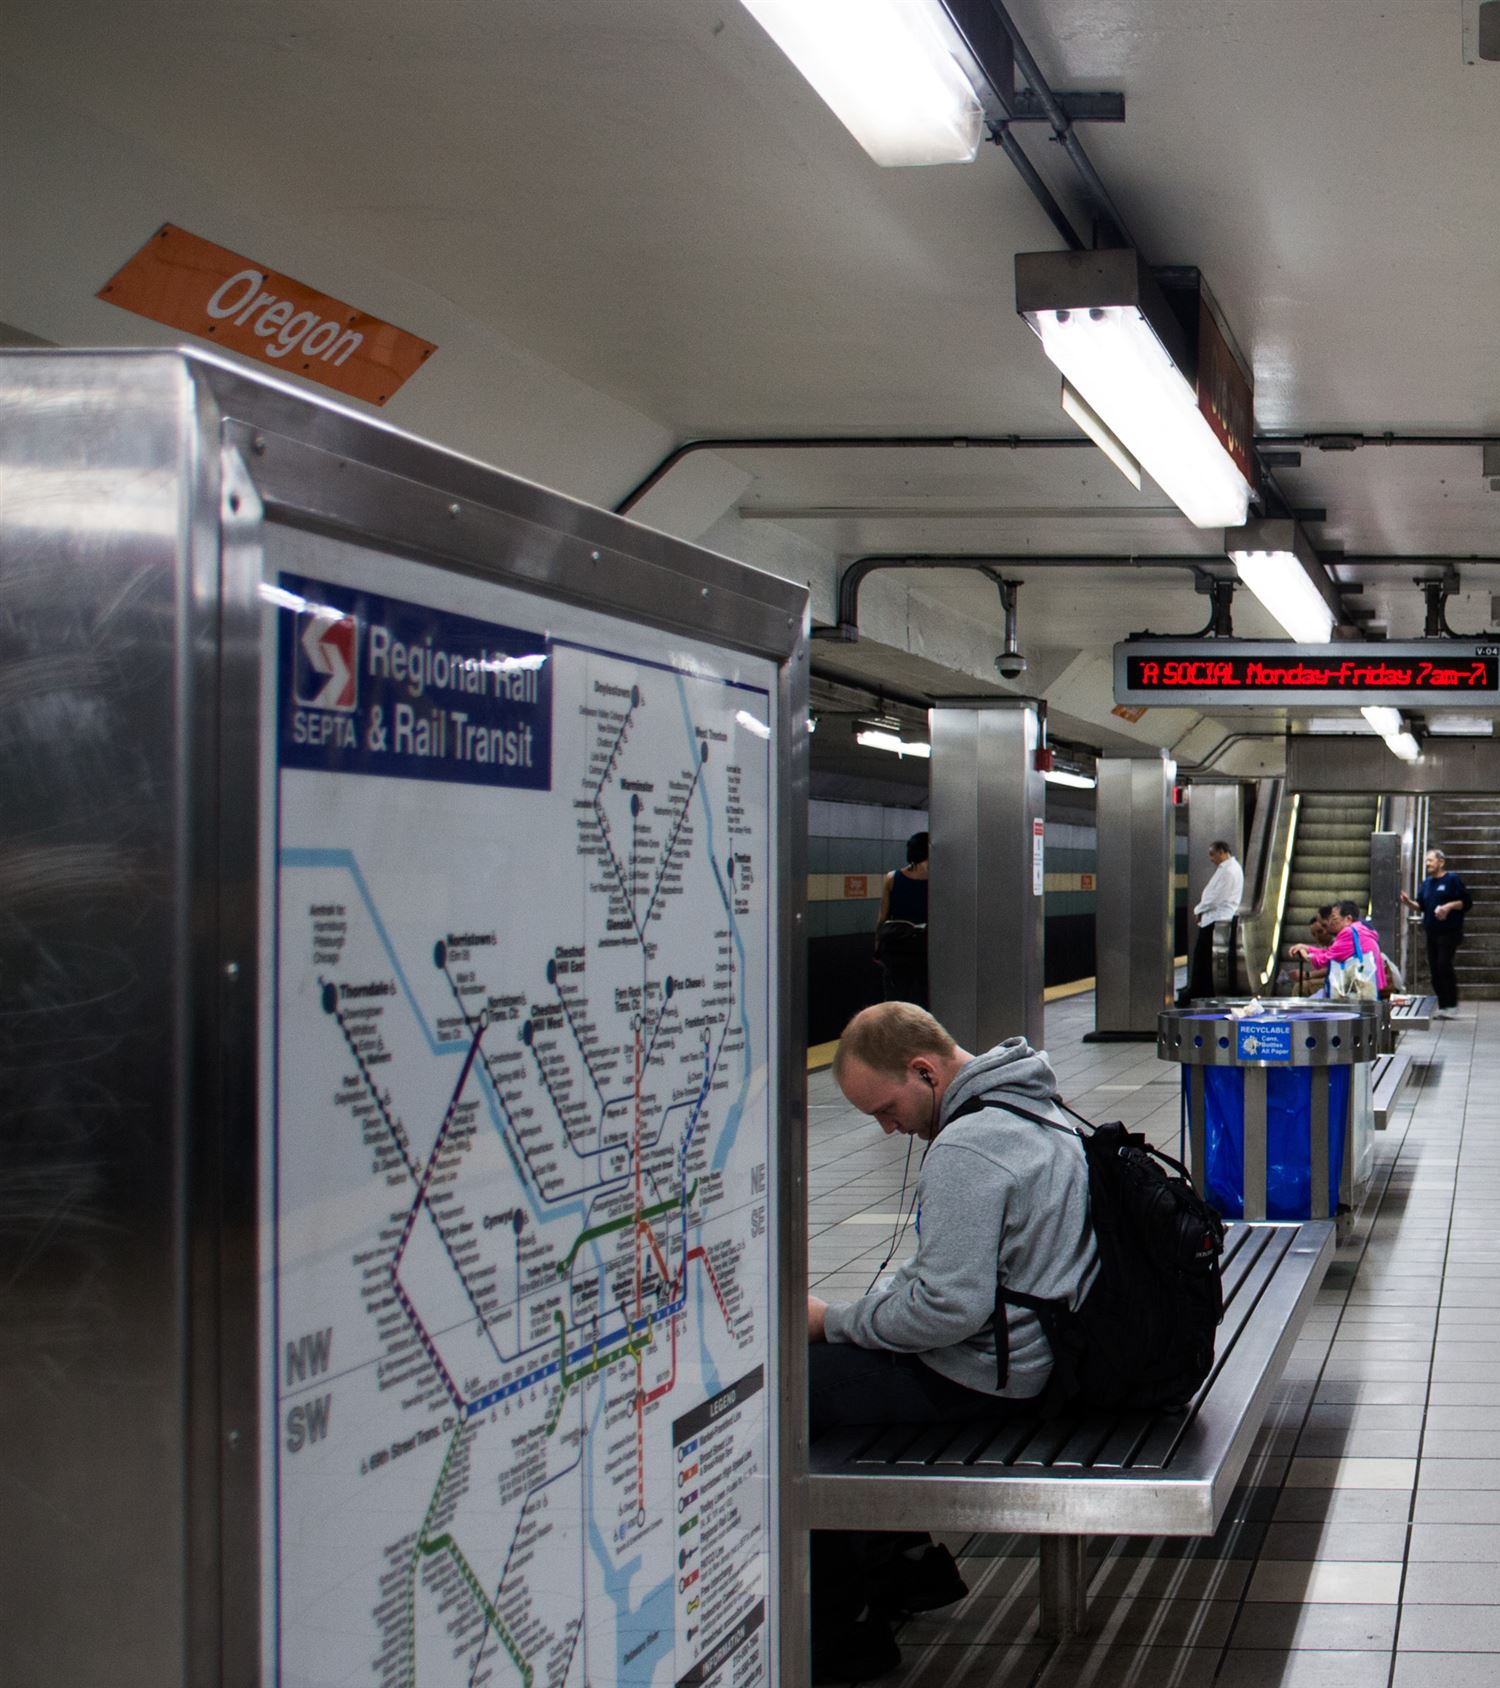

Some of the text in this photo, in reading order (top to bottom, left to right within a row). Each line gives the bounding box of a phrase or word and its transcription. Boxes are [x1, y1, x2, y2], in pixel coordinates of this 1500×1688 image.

[206, 269, 364, 367] Oregon
[369, 624, 487, 698] Regional
[1162, 662, 1240, 684] SOCIAL
[293, 711, 357, 750] SEPTA
[367, 703, 533, 769] & Rail Transit
[340, 982, 389, 999] Thorndale
[1240, 1026, 1290, 1034] RECYCLABLE
[750, 1162, 766, 1195] NE
[286, 1327, 333, 1386] NW
[286, 1393, 332, 1453] SW
[709, 1390, 737, 1417] LEGEND
